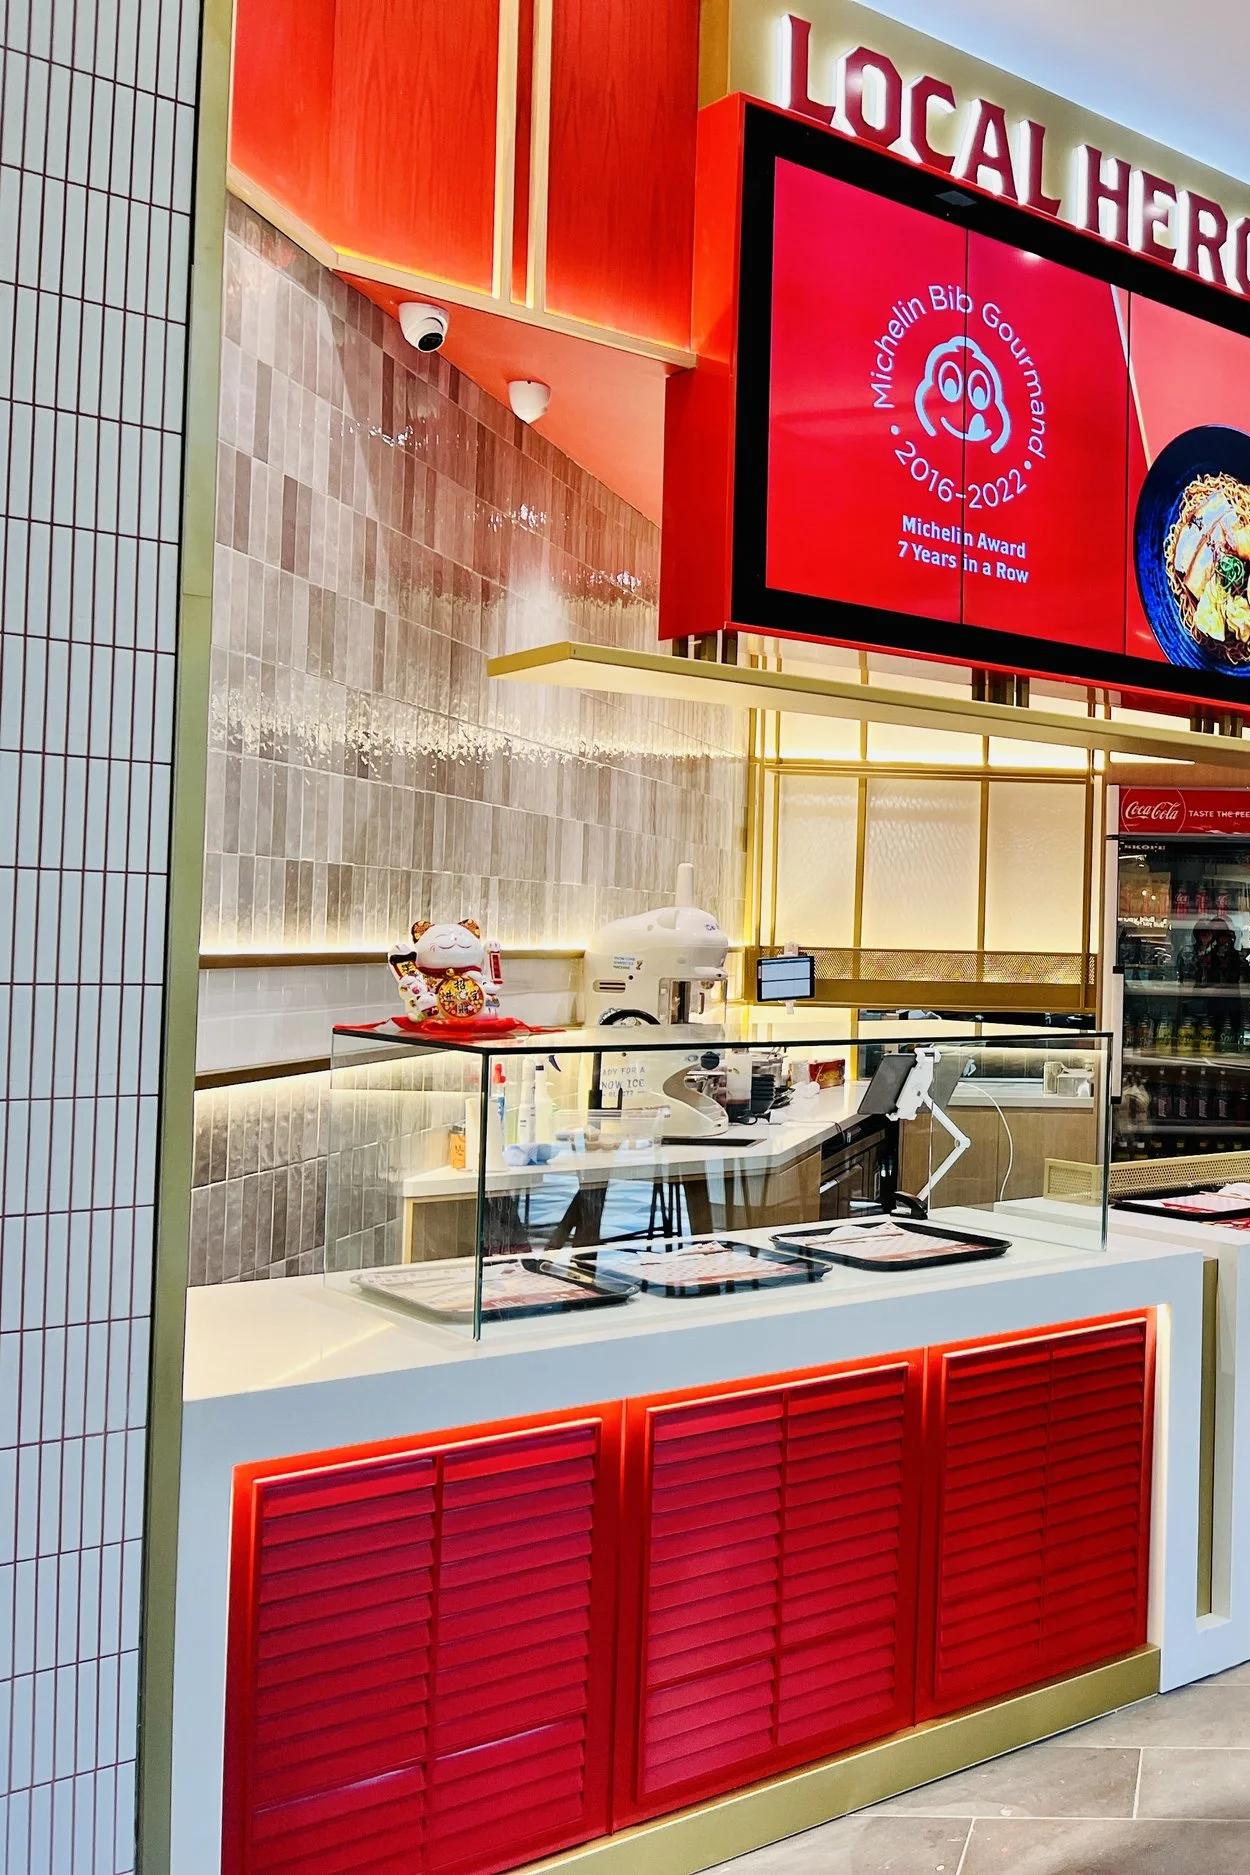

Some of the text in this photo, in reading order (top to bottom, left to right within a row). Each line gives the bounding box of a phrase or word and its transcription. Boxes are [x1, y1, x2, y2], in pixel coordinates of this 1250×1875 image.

[781, 14, 1062, 216] LOCAL
[870, 284, 1047, 459] Michelin Bib Gourmand
[902, 515, 1027, 560] Michelin Award
[897, 540, 1029, 584] 7 Years in a Row
[1188, 810, 1214, 818] TASTE
[1216, 810, 1233, 818] THE
[627, 1078, 645, 1088] ICE
